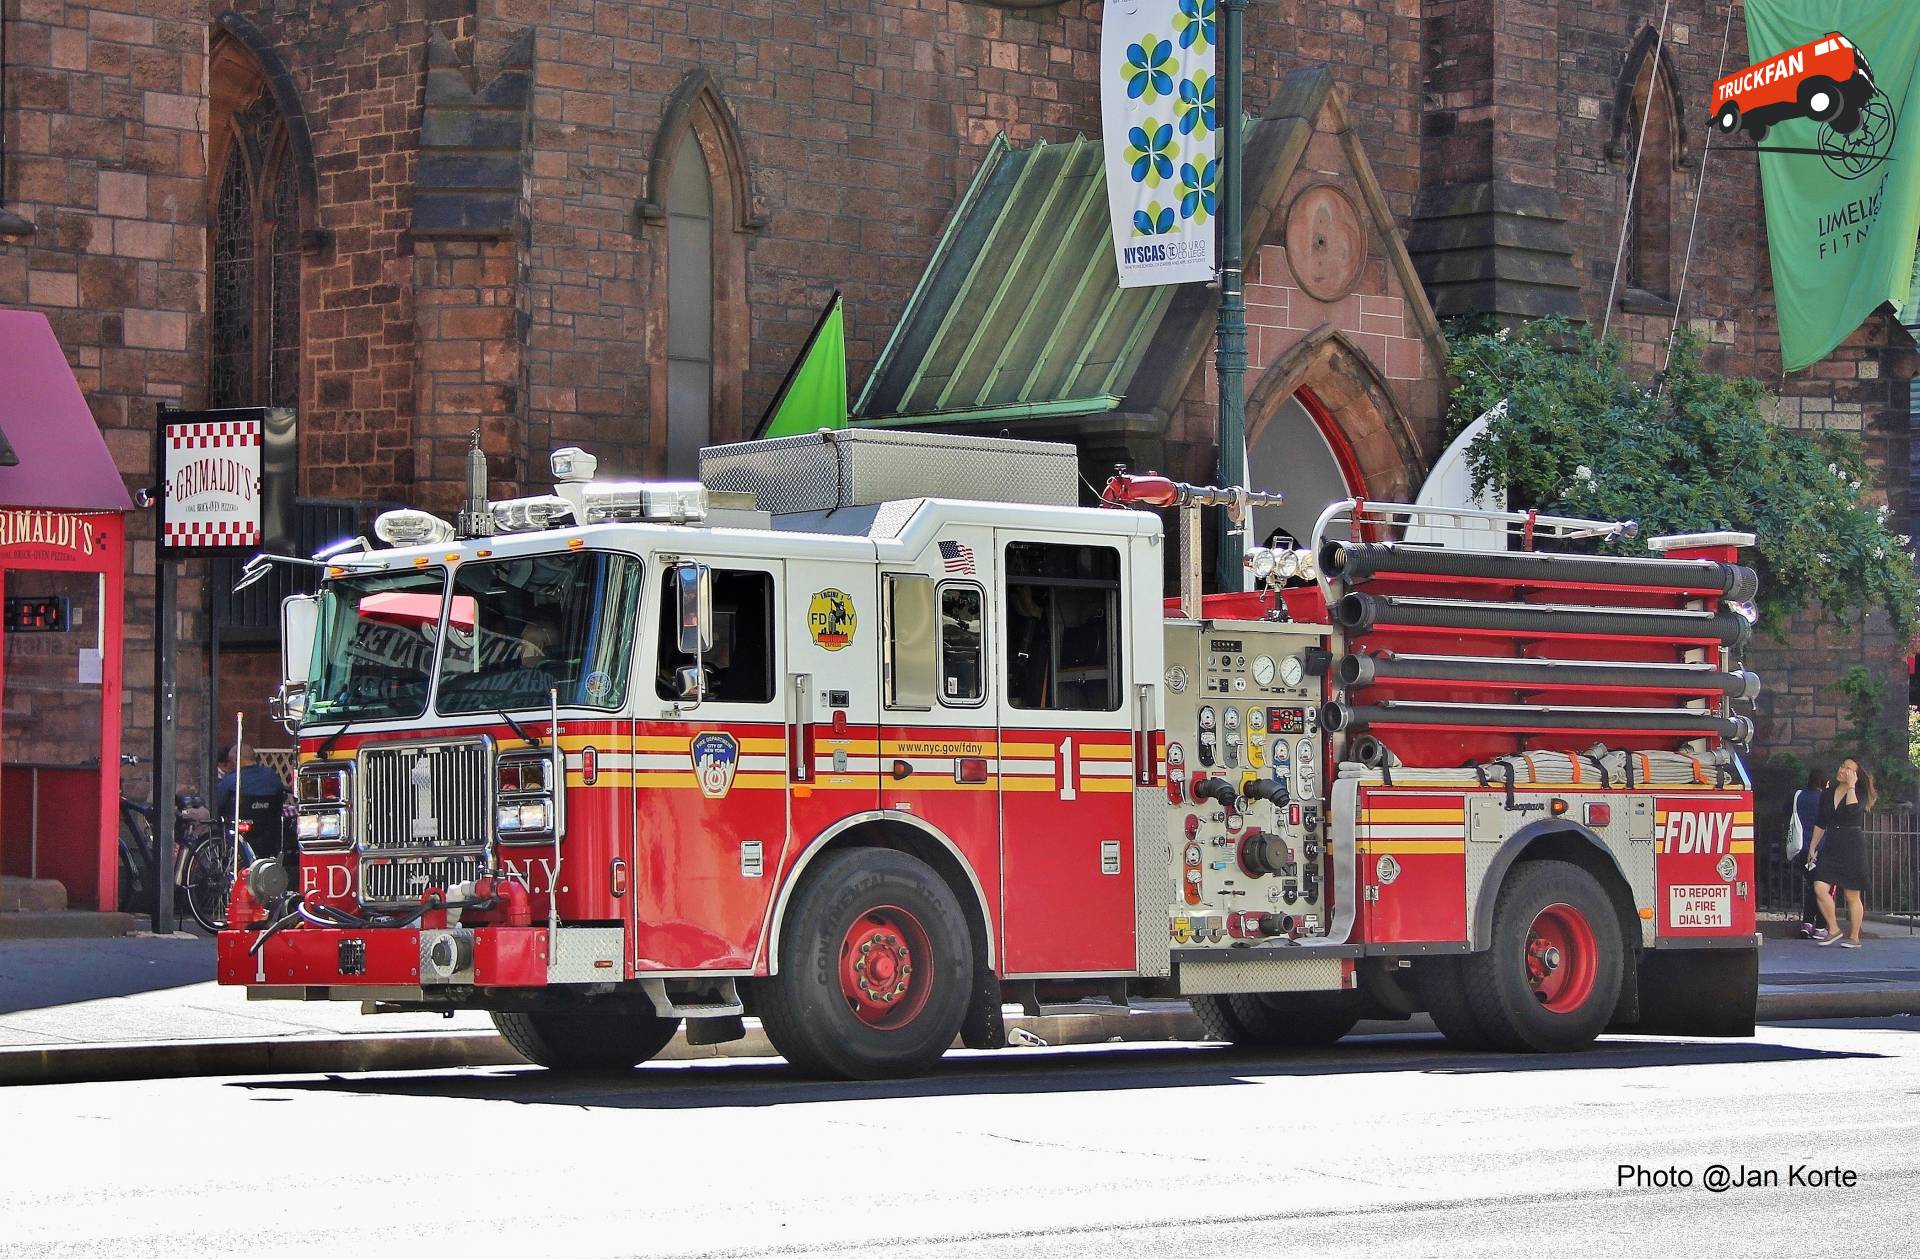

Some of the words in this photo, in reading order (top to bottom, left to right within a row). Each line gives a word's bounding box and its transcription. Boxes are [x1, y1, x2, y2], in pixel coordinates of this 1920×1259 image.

[1178, 240, 1206, 251] TOURO
[1124, 244, 1166, 264] NYSCAS
[1178, 248, 1206, 259] COLLEGE
[176, 458, 251, 502] GRIMALDI'S
[811, 612, 828, 625] FD
[897, 742, 983, 754] www.nyc.gov/fdny
[1059, 736, 1076, 801] 1
[411, 757, 439, 838] 1
[1664, 811, 1732, 854] FDNY
[1673, 888, 1686, 898] TO
[1689, 888, 1728, 898] REPORT
[1685, 901, 1692, 911] A
[1695, 901, 1716, 911] FIRE
[1679, 914, 1702, 925] DIAL
[1704, 914, 1722, 925] 911
